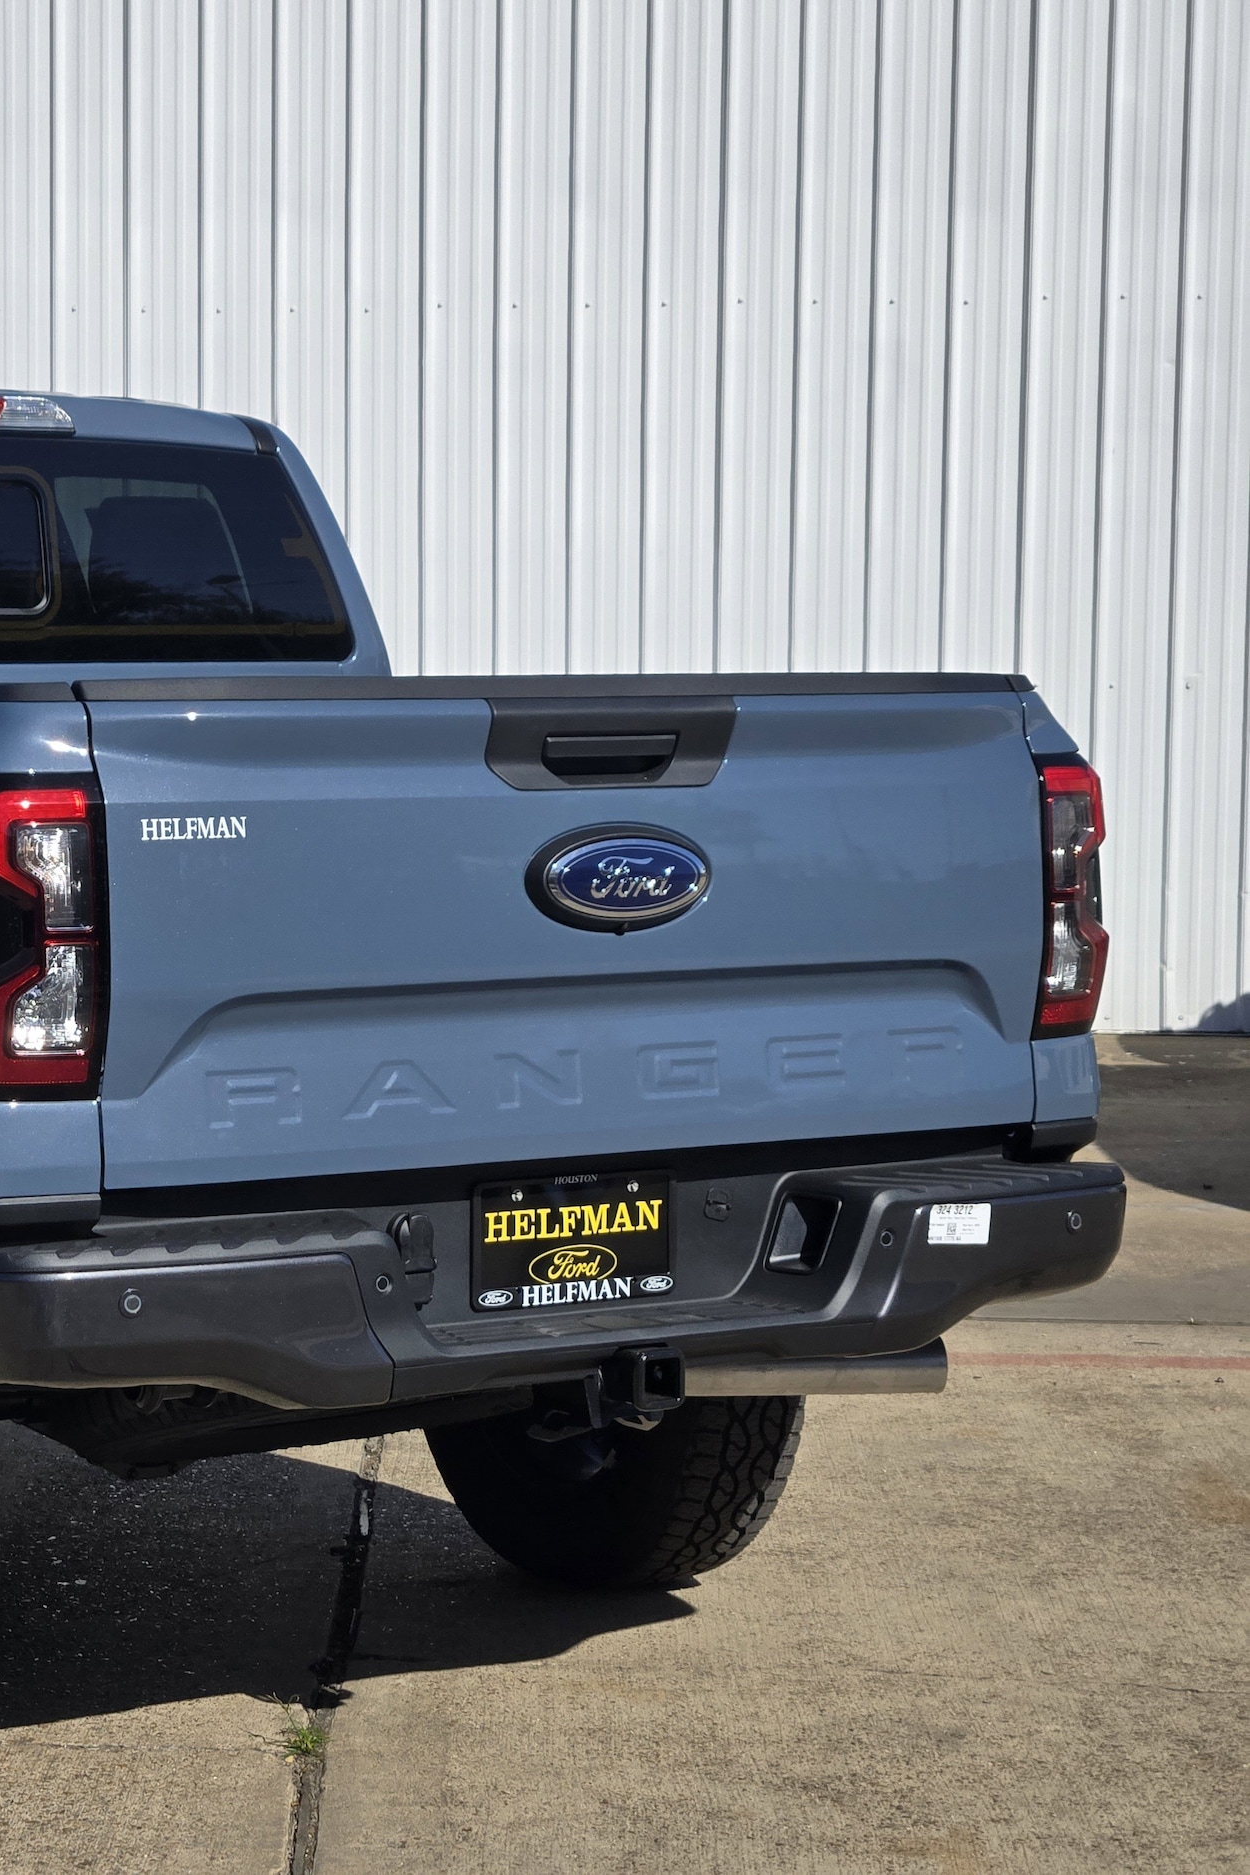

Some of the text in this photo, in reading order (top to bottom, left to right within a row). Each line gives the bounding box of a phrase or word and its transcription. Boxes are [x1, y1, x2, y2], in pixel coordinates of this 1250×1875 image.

[140, 816, 247, 841] HELFMAN
[590, 855, 674, 899] Ford
[554, 1174, 598, 1185] HOUSTON
[484, 1199, 663, 1243] HELFMAN
[548, 1250, 601, 1279] Ford
[521, 1276, 633, 1308] HELFMAN
[645, 1277, 669, 1290] Ford
[484, 1291, 508, 1305] Ford
